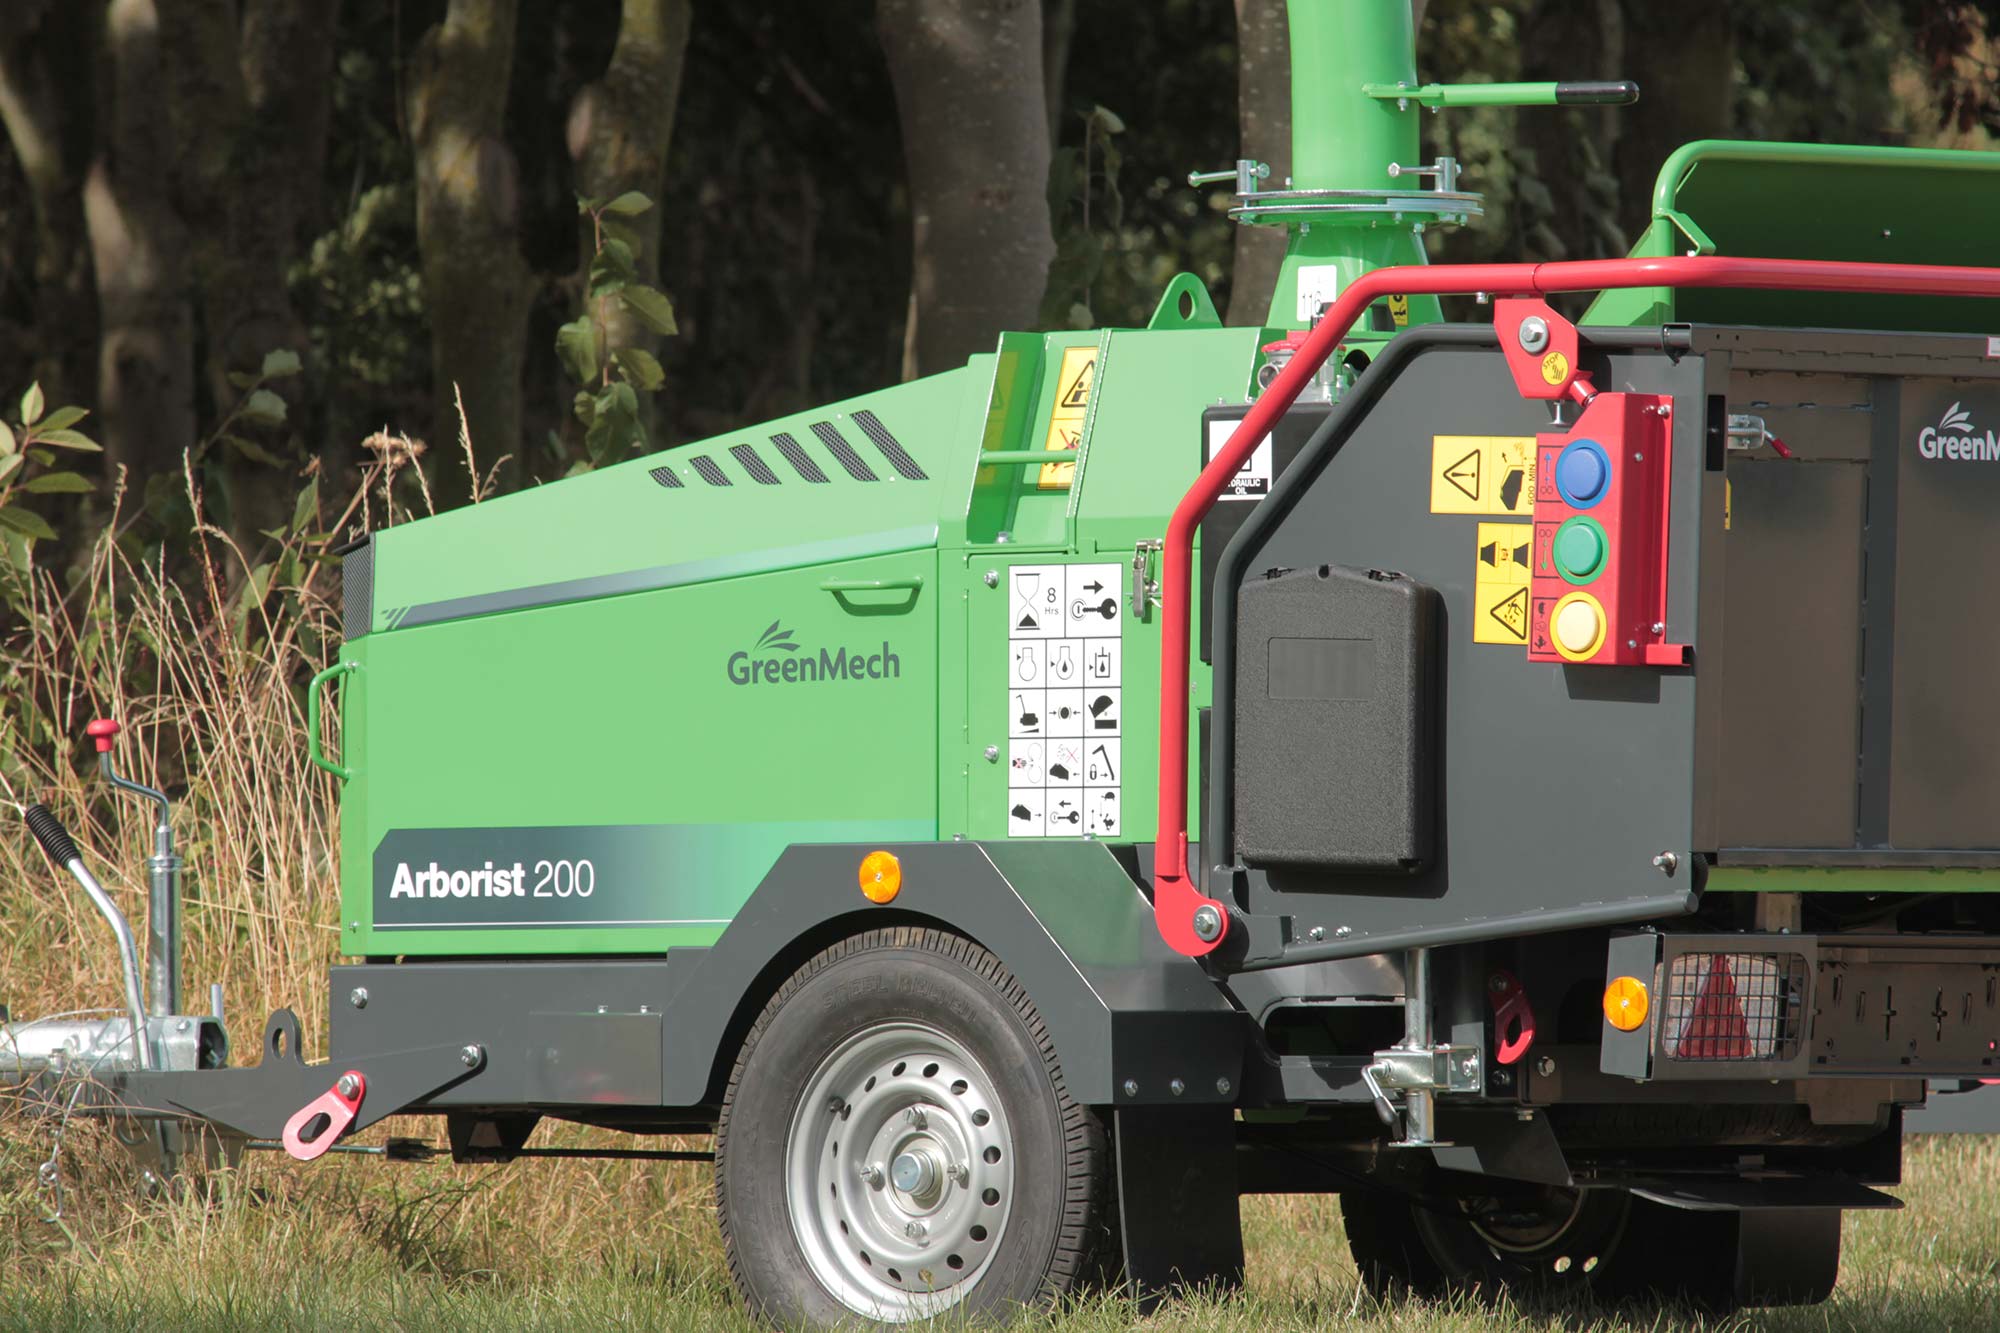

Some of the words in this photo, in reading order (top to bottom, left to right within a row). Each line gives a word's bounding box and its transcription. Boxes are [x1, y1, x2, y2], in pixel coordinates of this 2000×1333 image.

[1543, 353, 1559, 370] STOP
[1528, 464, 1536, 482] MIN
[1227, 479, 1261, 488] DRAULIC
[1236, 487, 1247, 495] OIL
[1527, 486, 1535, 505] 600
[1047, 587, 1056, 603] 8
[1044, 607, 1059, 615] Hrs
[727, 641, 900, 686] GreenMech
[389, 862, 526, 899] Arborist
[533, 859, 595, 898] 200
[822, 974, 889, 1010] STEEL
